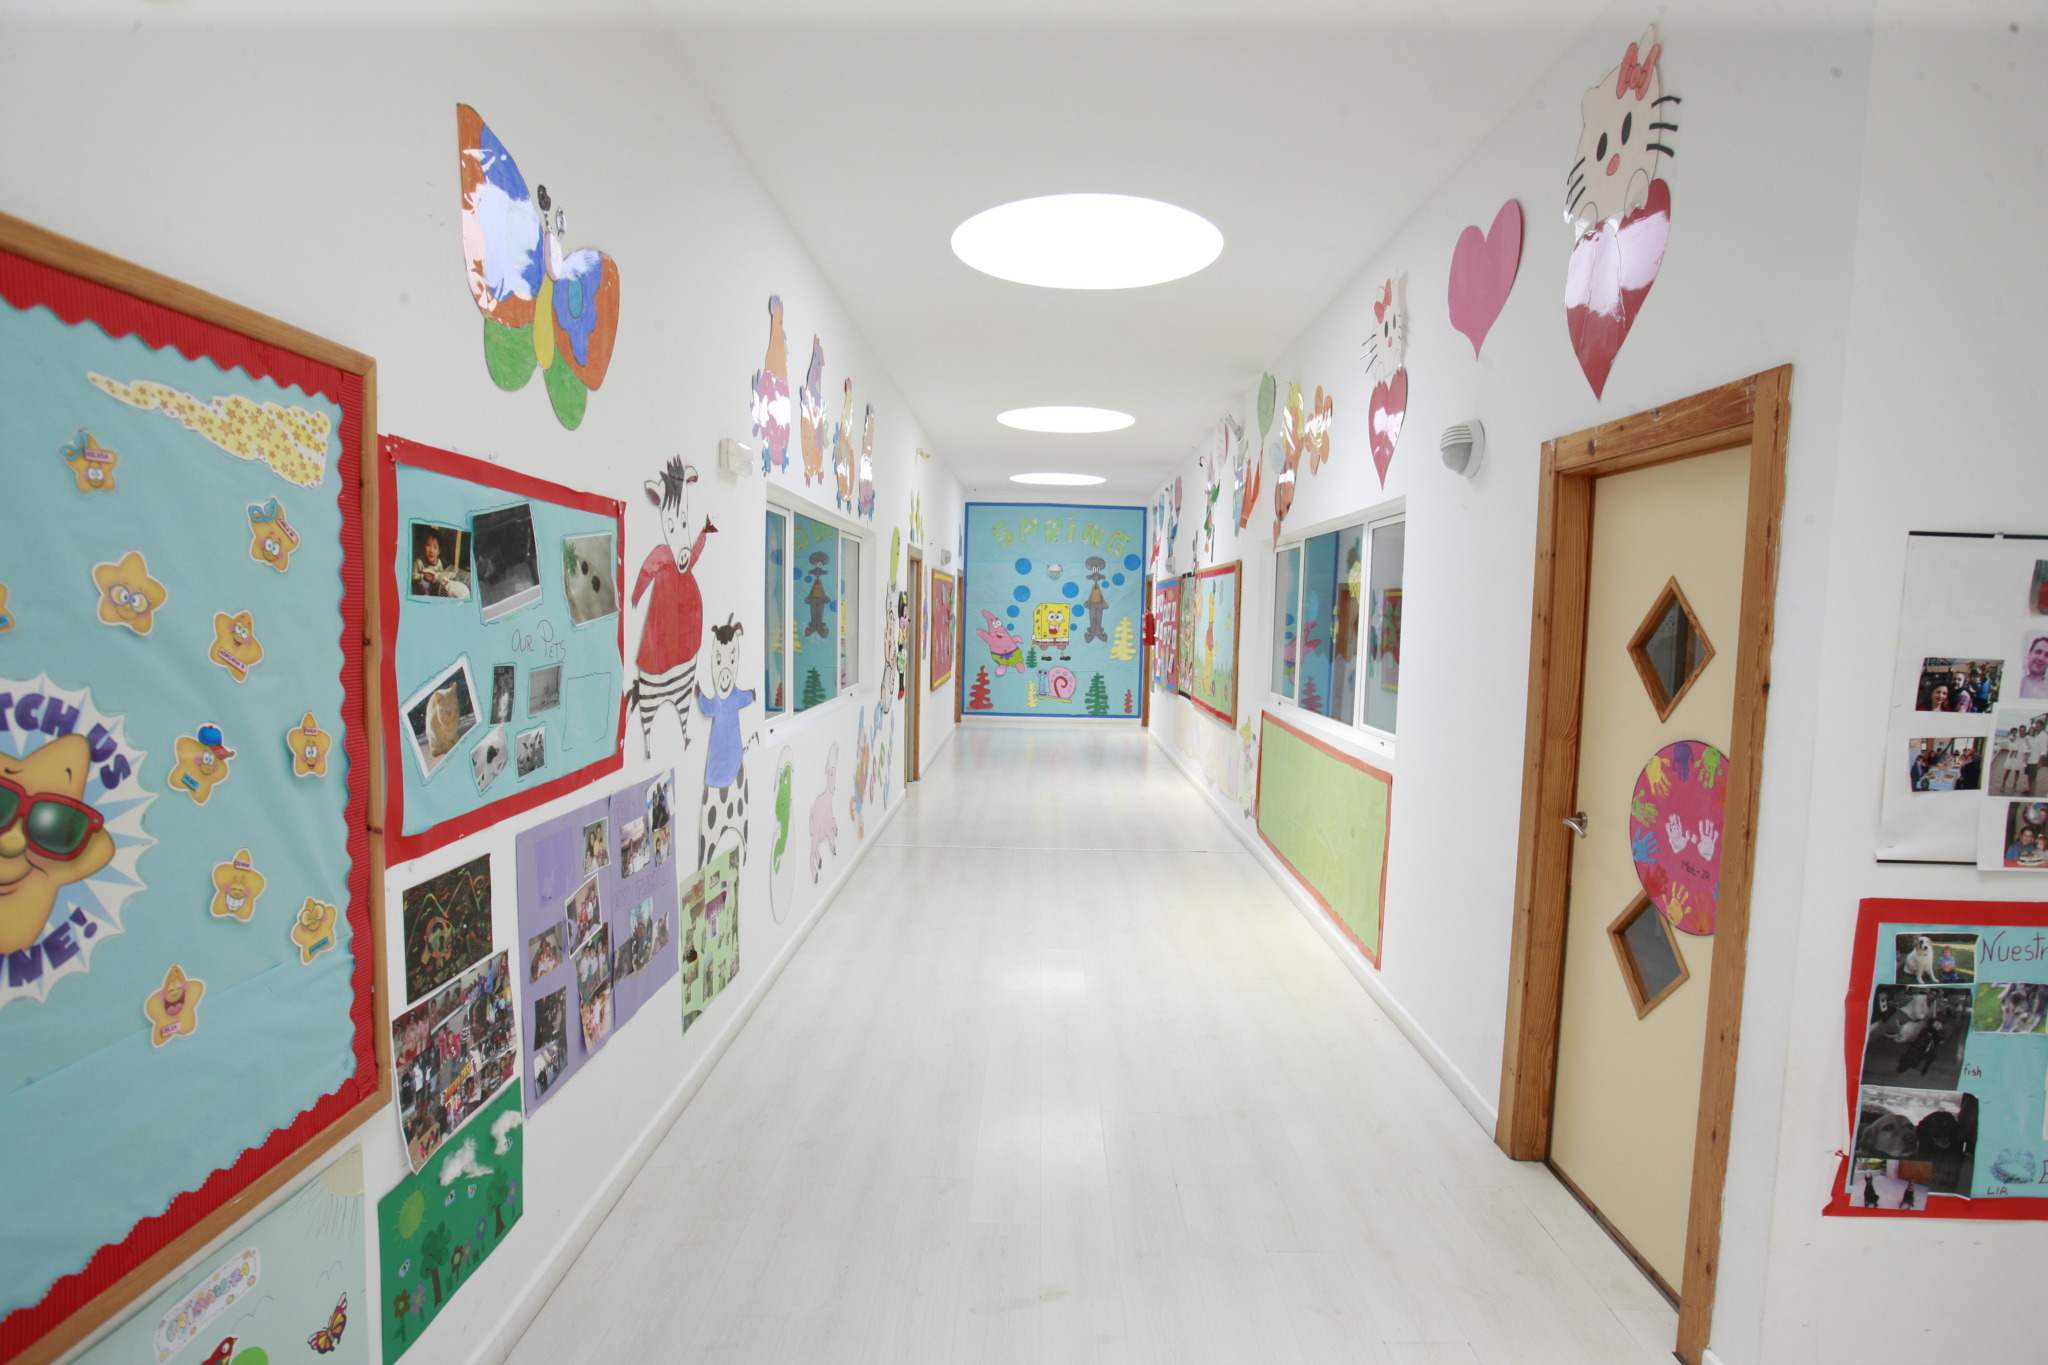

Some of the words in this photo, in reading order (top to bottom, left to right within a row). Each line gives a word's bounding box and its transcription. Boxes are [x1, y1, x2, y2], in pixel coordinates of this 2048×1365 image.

[511, 629, 535, 652] OUR
[537, 619, 566, 663] PETS
[87, 722, 131, 790] US
[1963, 1063, 1982, 1078] fish
[1987, 1186, 2008, 1196] LIA
